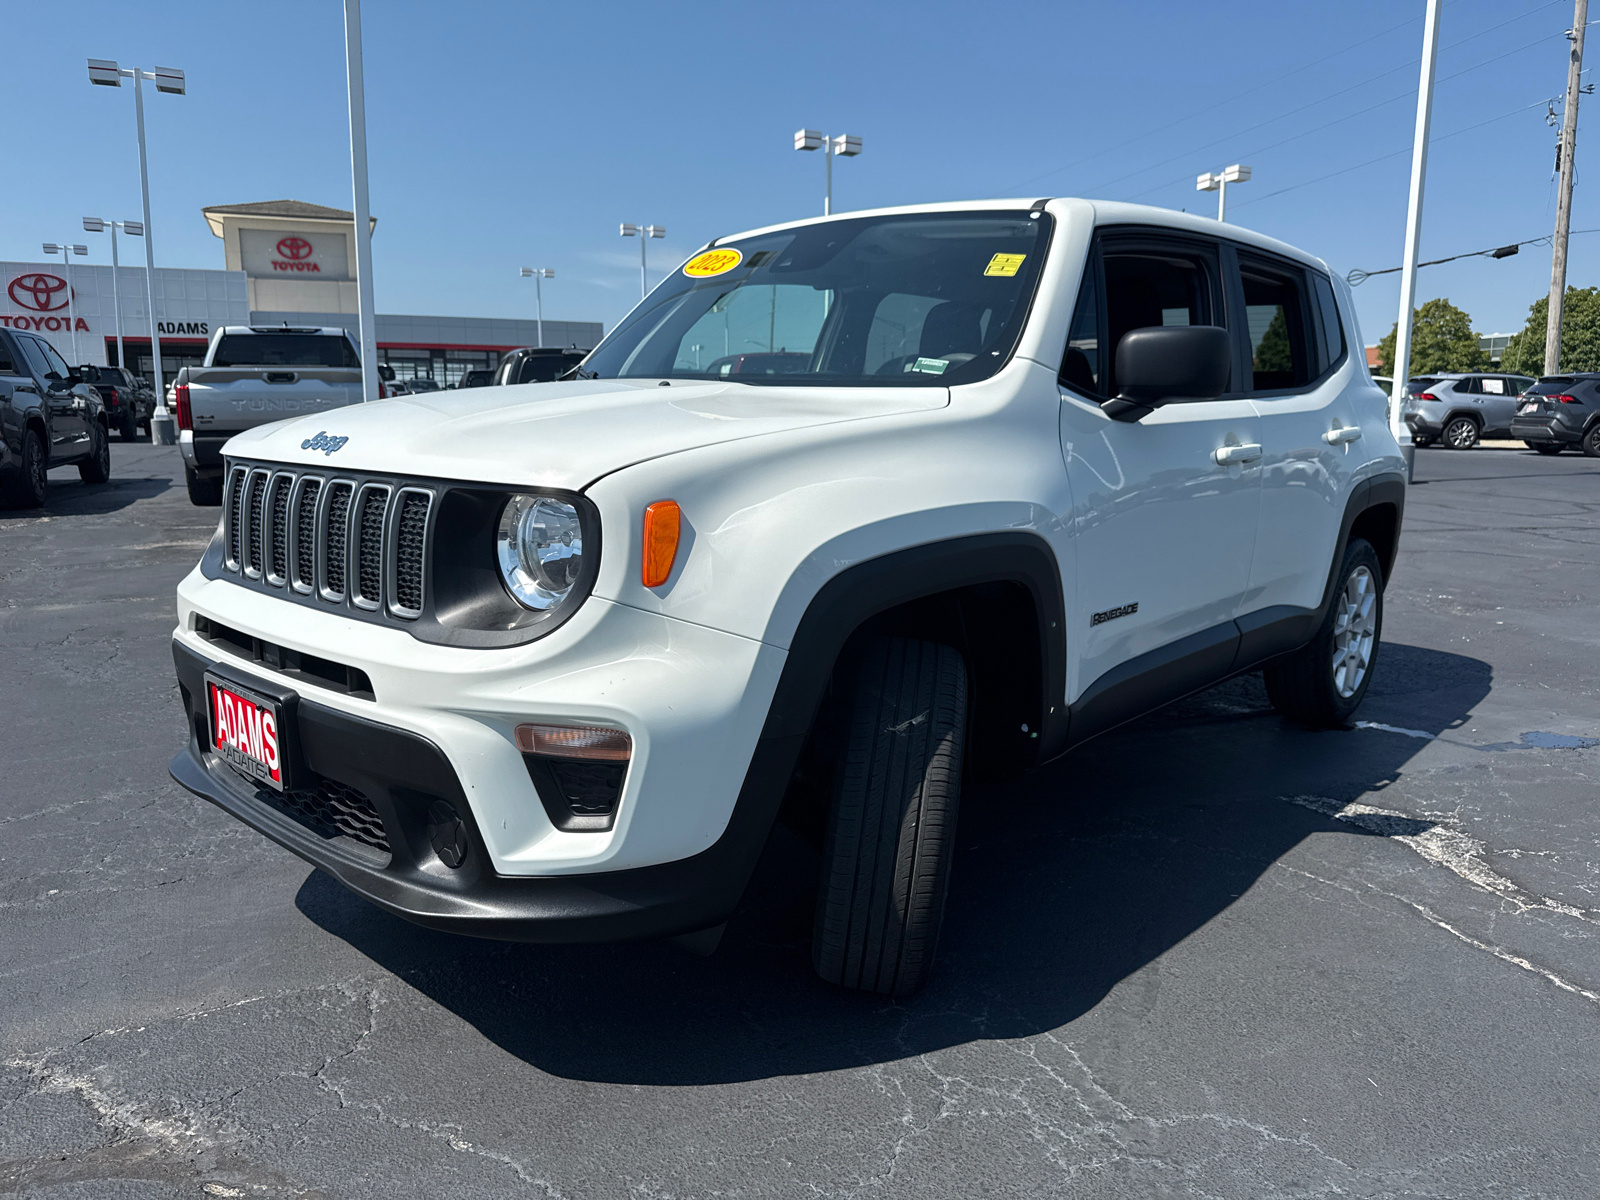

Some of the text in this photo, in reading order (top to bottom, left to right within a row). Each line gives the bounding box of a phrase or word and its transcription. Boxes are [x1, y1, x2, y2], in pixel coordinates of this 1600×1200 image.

[271, 260, 321, 272] TOYOTA
[688, 254, 736, 272] 2023
[0, 315, 90, 332] TOYOTA
[157, 321, 209, 335] ADAMS
[300, 430, 349, 457] Jeep
[1090, 601, 1139, 628] RENEGADE
[215, 689, 279, 771] ADAMS
